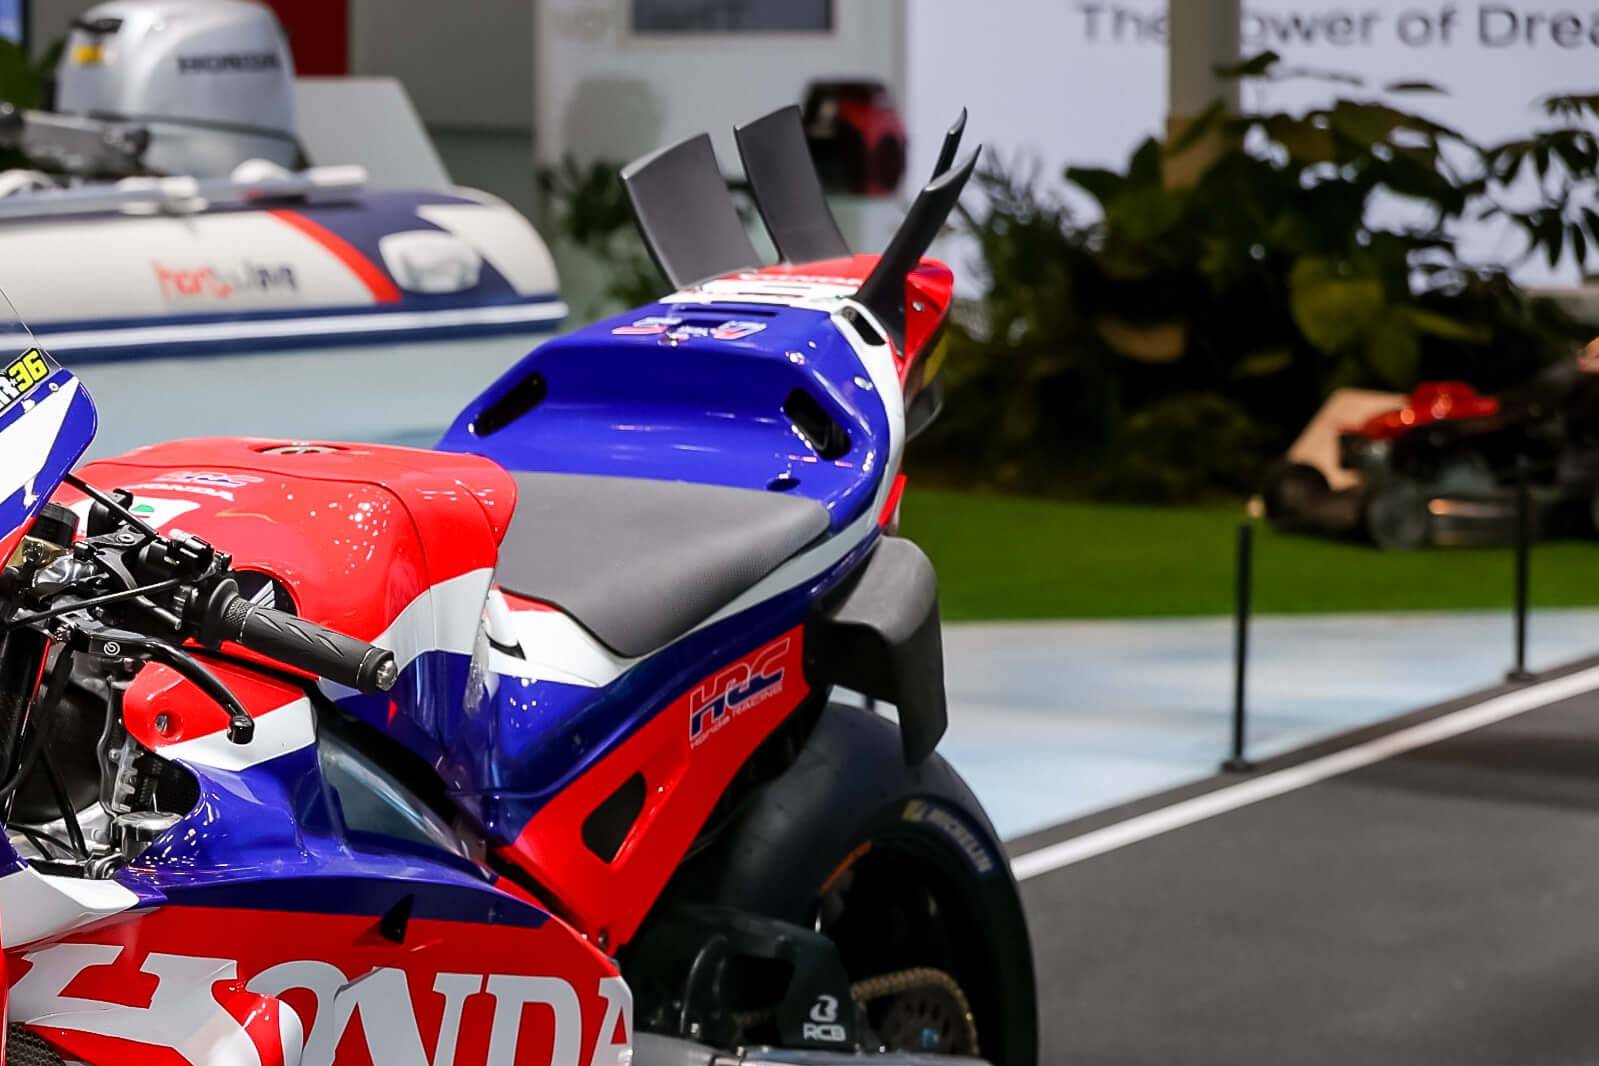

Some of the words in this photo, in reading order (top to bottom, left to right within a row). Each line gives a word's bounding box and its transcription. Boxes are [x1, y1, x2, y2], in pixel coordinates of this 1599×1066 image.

[1074, 5, 1168, 45] The
[1238, 13, 1380, 46] ower
[1399, 4, 1457, 46] of
[689, 637, 791, 741] HRC
[803, 1023, 846, 1042] RCB
